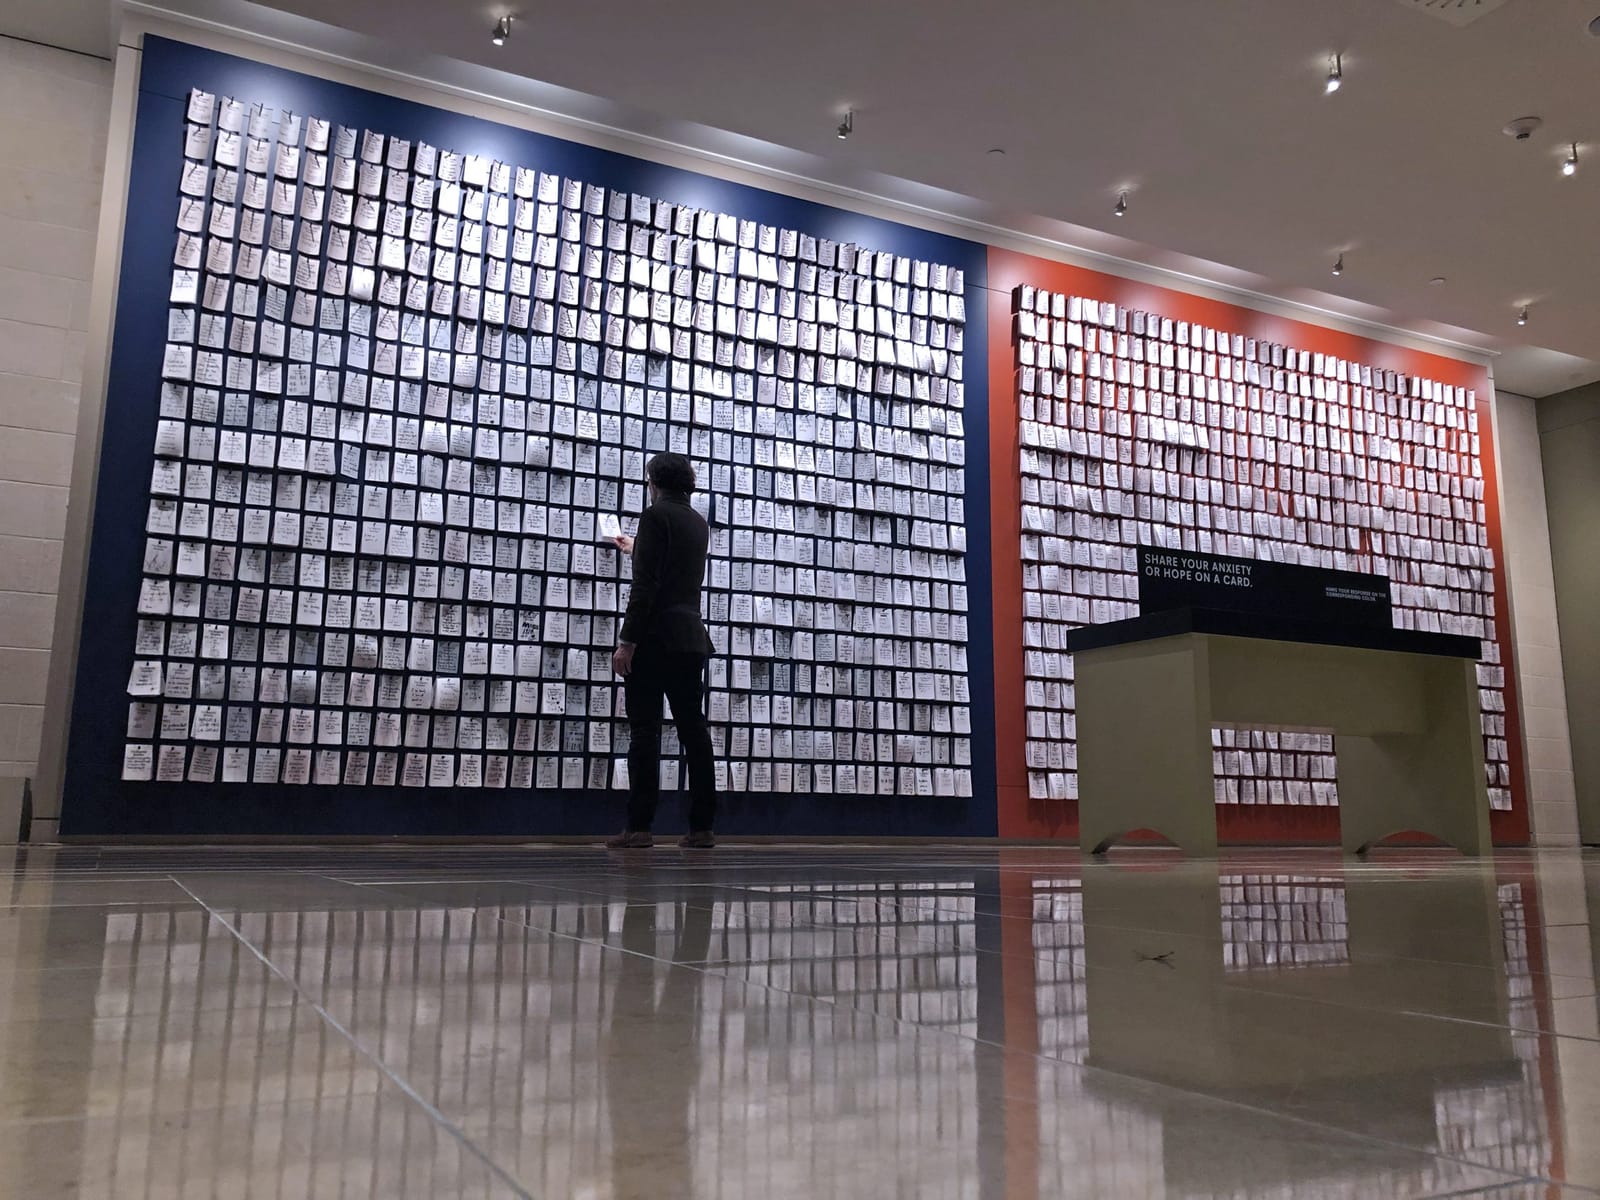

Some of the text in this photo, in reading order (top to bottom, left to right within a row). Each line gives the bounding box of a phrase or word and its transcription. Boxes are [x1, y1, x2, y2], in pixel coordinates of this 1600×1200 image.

[1144, 553, 1252, 576] SHARE YOUR ANXIETY
[1145, 565, 1253, 588] OR HOPE ON A CARD.
